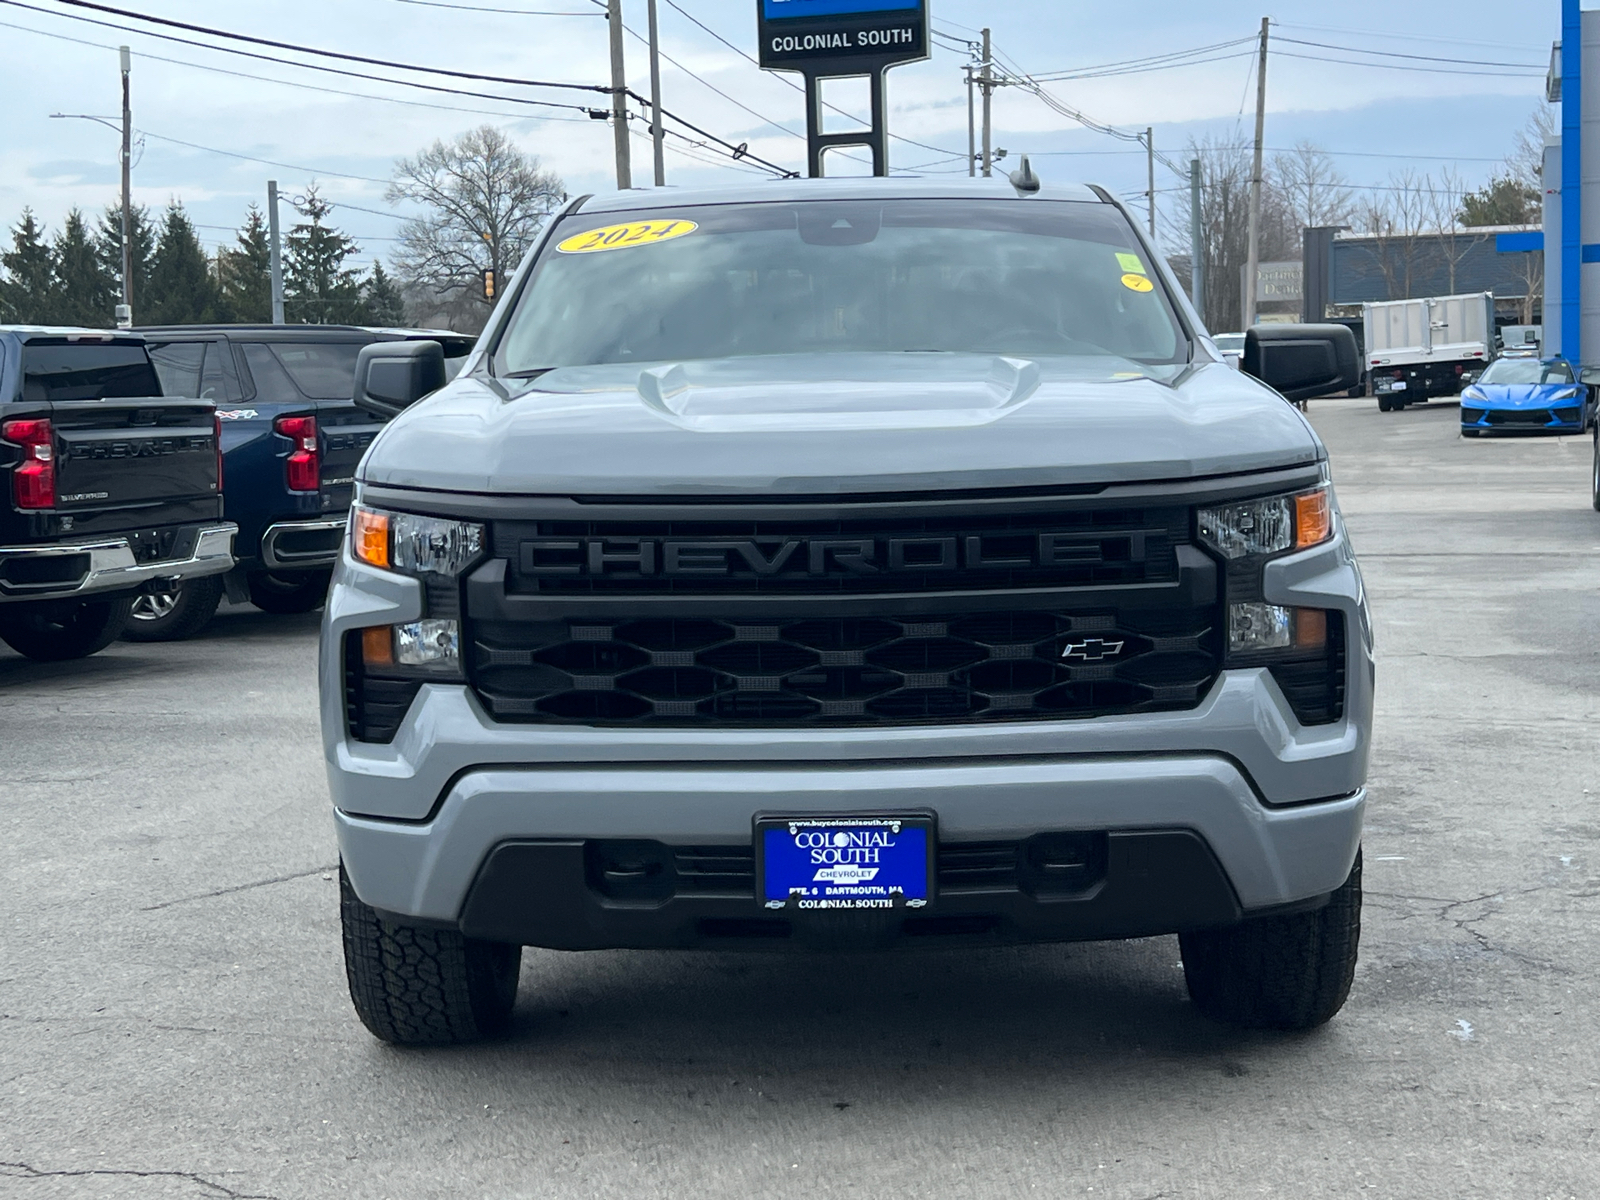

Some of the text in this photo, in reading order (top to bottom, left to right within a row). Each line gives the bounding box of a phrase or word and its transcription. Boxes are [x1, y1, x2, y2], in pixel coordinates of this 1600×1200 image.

[772, 28, 913, 52] COLONIAL SOUTH
[577, 221, 680, 250] 2024
[518, 527, 1169, 575] CHEVROLET
[788, 820, 902, 828] www.buycolonialsouth.com
[795, 831, 896, 848] COLONIAL
[810, 847, 881, 864] SOUTH
[819, 870, 873, 878] CHEVROLET
[811, 887, 818, 895] 6
[825, 886, 887, 895] DARTMOUTH,
[798, 899, 893, 909] COLONIAL SOUTH
